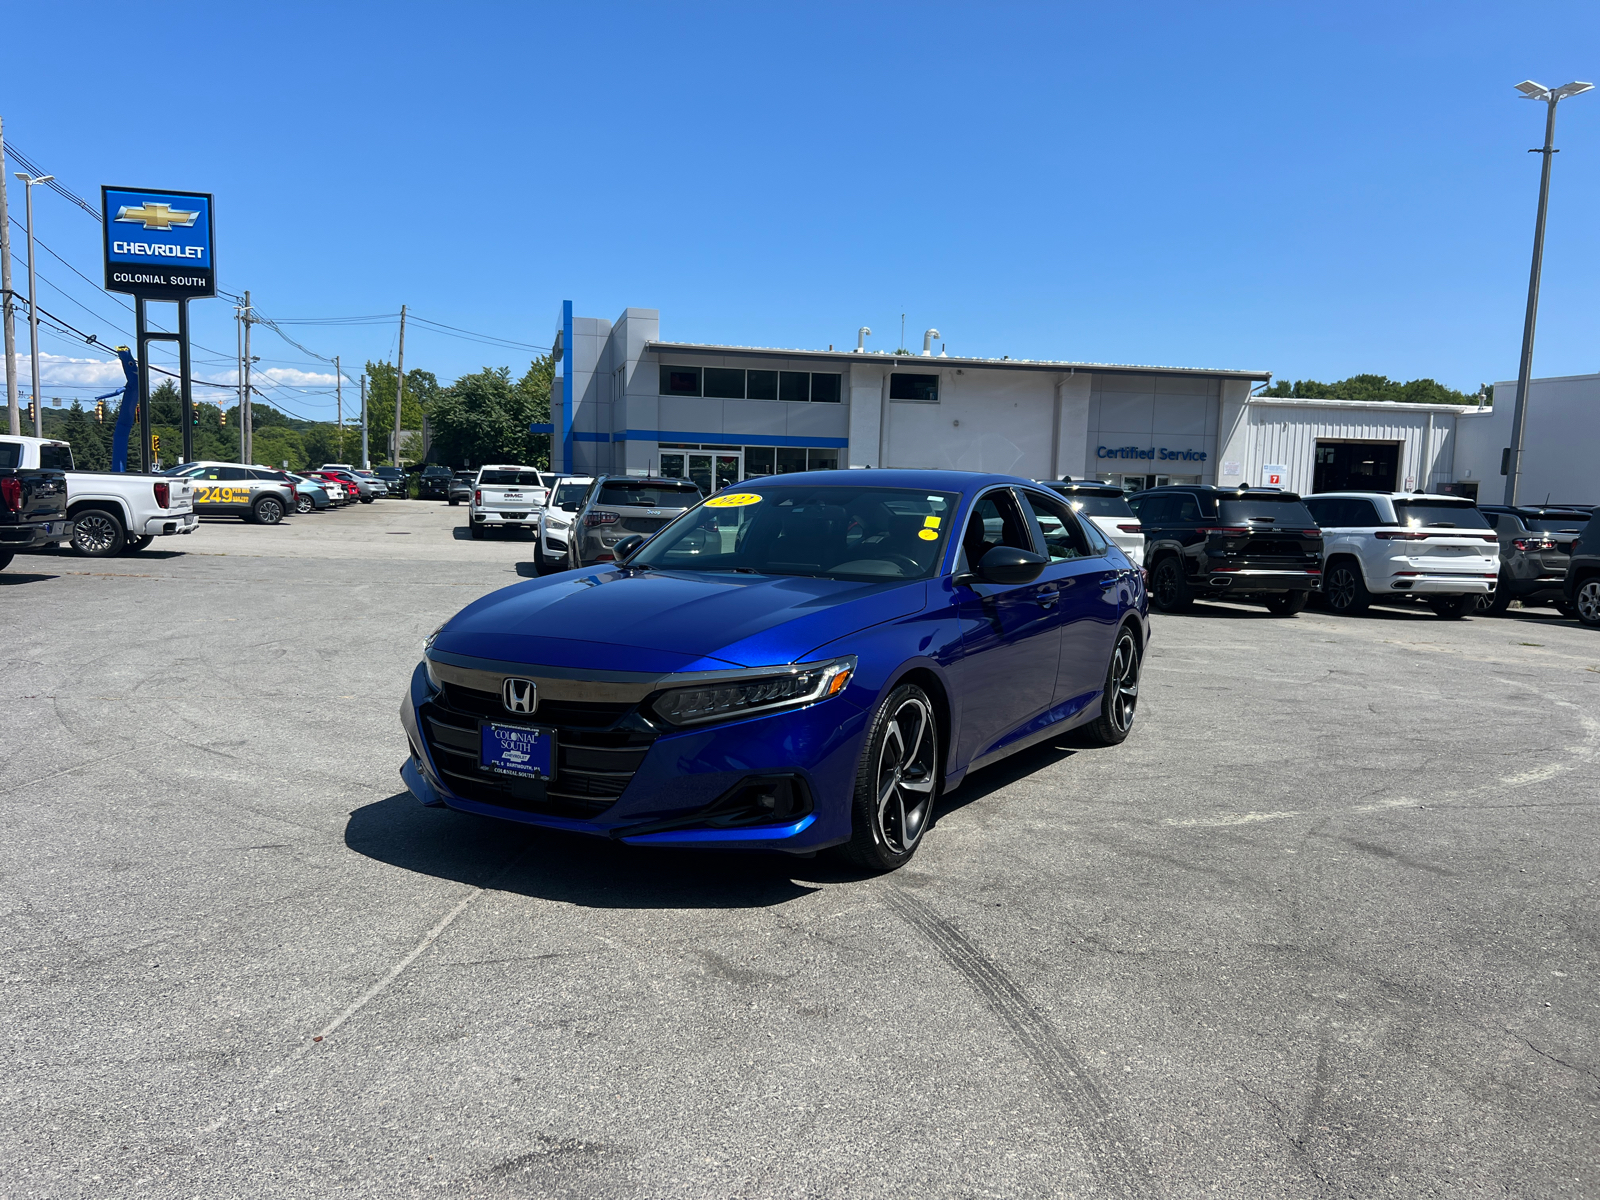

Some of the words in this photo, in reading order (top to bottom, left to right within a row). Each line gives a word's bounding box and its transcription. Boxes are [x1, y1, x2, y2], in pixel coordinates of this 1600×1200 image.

[113, 241, 204, 259] CHEVROLET
[113, 272, 167, 285] COLONIAL
[170, 276, 206, 287] SOUTH
[1097, 446, 1155, 460] Certified
[1159, 447, 1207, 462] Service
[495, 730, 537, 744] COLONIAL
[501, 740, 531, 752] SOUTH
[504, 752, 527, 760] CHEVROLET
[494, 768, 517, 776] COLONIAL
